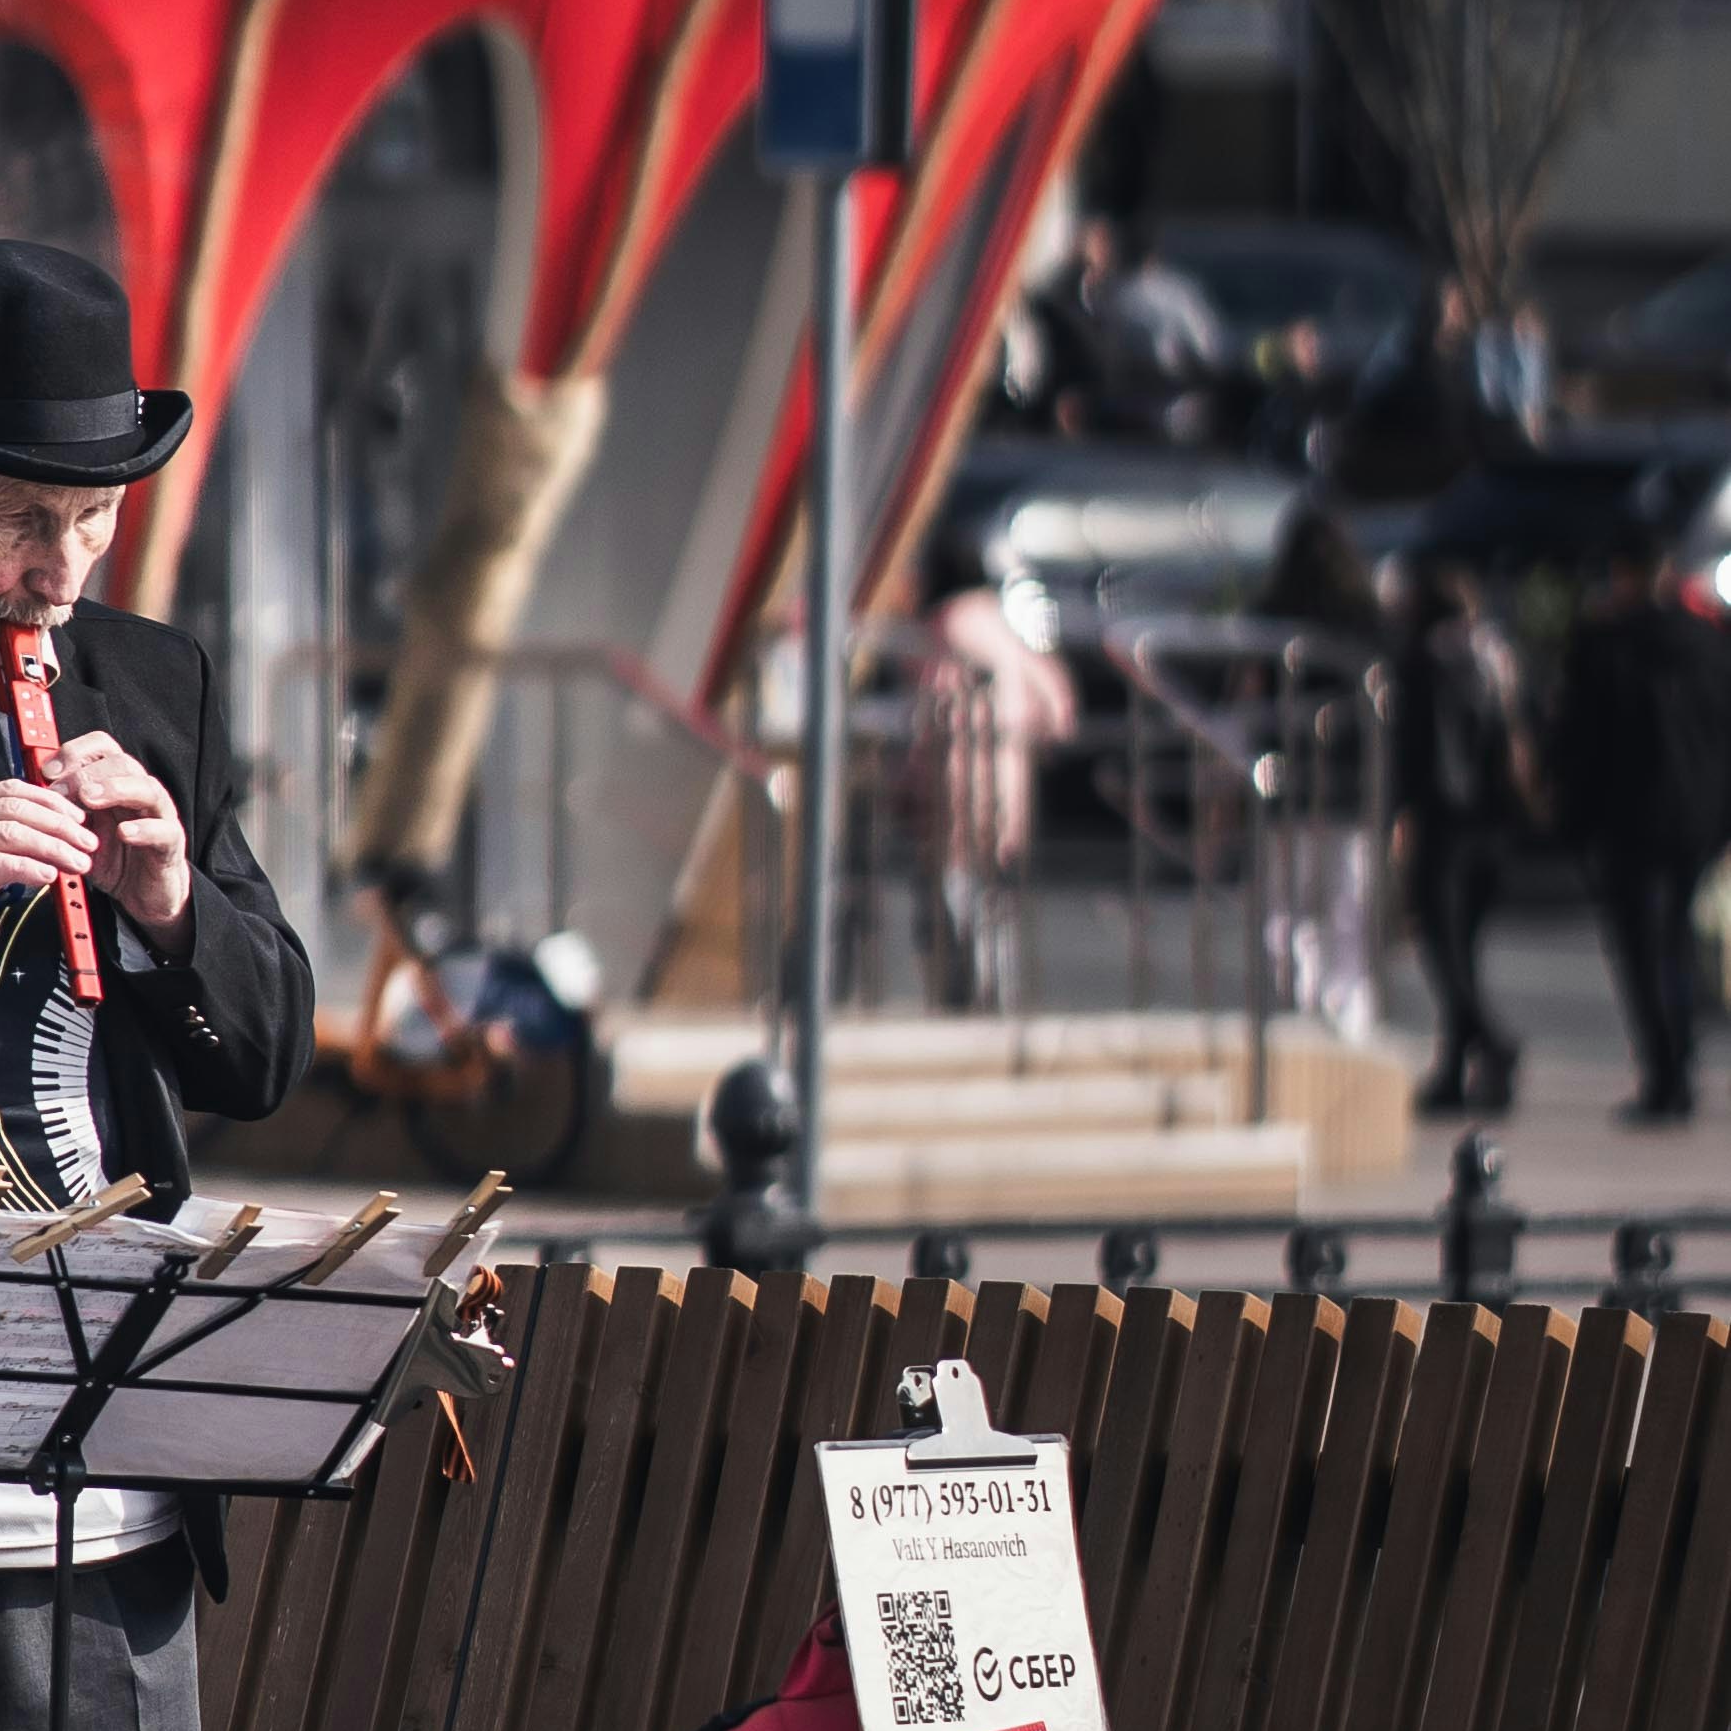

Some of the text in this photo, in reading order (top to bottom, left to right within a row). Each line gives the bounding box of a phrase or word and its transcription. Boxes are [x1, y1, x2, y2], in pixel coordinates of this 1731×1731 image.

[849, 1480, 1052, 1526] 8 (977) 593-01-31
[892, 1532, 1028, 1561] Vali Y Hasanovich
[1009, 1653, 1076, 1690] СБЕР
